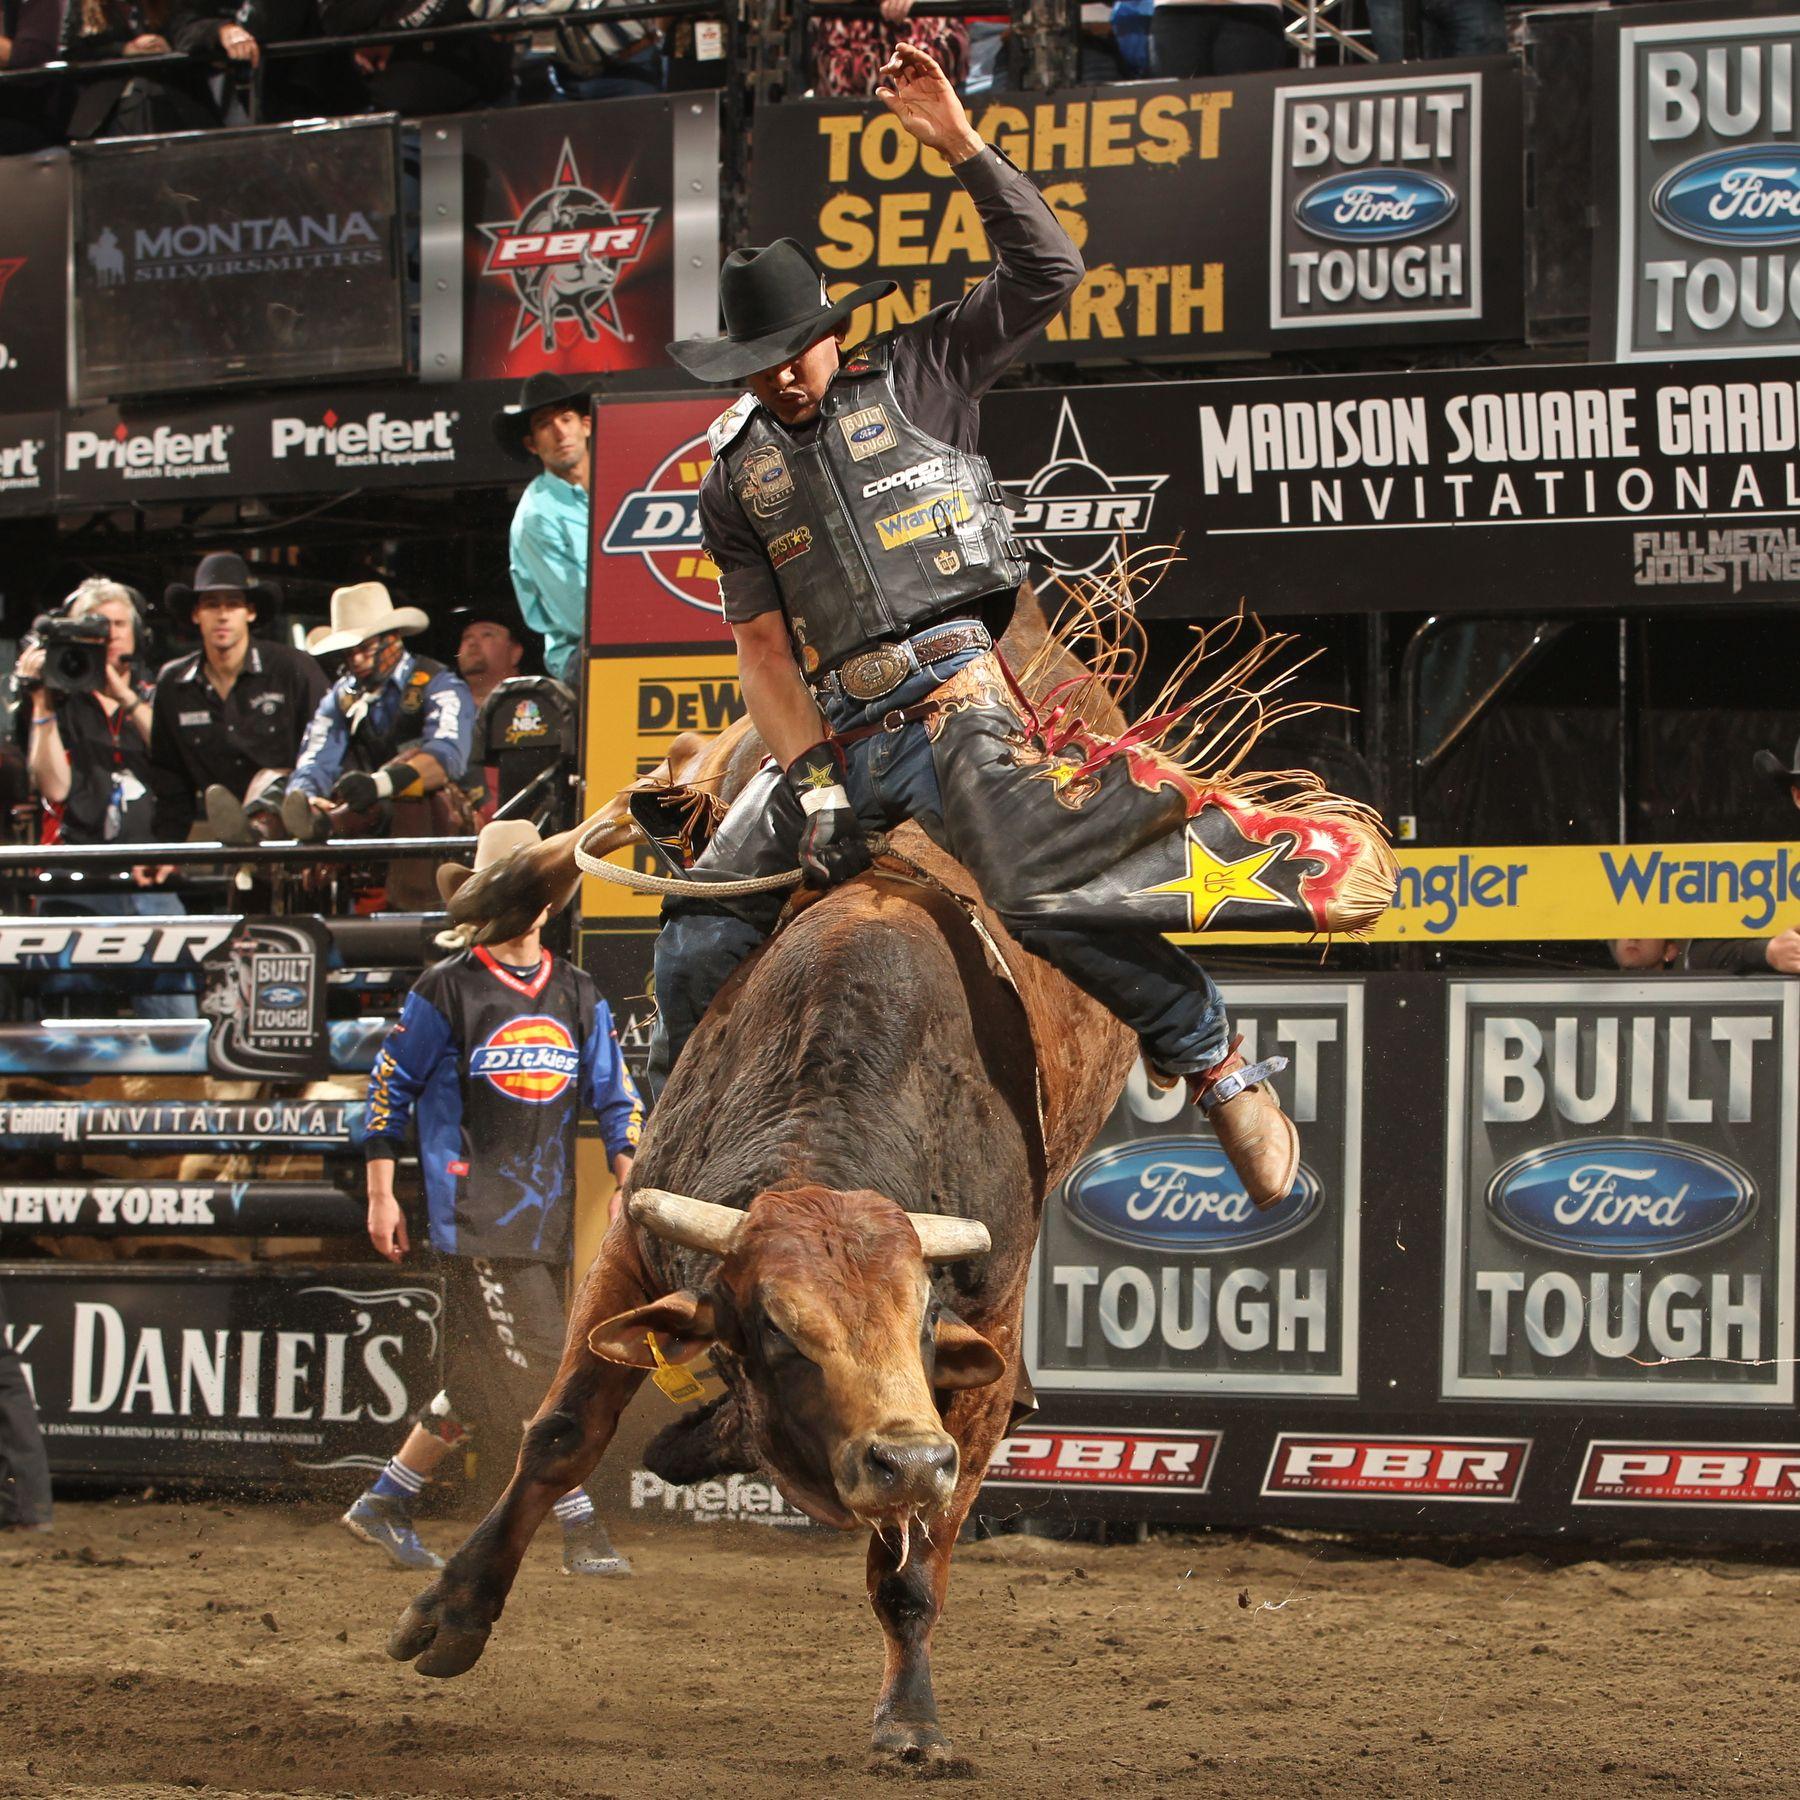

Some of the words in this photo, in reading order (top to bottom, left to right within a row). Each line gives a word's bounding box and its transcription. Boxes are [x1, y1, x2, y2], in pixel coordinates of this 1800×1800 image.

[1292, 93, 1464, 168] BUILT
[1333, 185, 1417, 223] Ford
[1708, 166, 1800, 221] For
[134, 211, 379, 260] MONTANA
[815, 181, 1089, 270] SEAS
[499, 229, 638, 261] PBR
[133, 250, 383, 282] SILVERSMITHS
[1288, 244, 1463, 304] TOUGH
[964, 262, 1225, 342] RTH
[272, 409, 453, 458] Priefert
[845, 408, 884, 432] BUILT
[1199, 397, 1430, 496] MADISON
[1445, 388, 1640, 464] SQUARE
[1656, 381, 1800, 456] GARD
[65, 422, 228, 471] Priefert
[381, 449, 455, 466] Equipment
[166, 463, 230, 479] Equipment
[1279, 463, 1800, 524] INVITATIONAL
[1002, 499, 1142, 531] PBR
[1633, 530, 1705, 567] FULL
[1708, 527, 1800, 556] METAL
[1634, 552, 1800, 594] JOUSTING
[512, 717, 542, 731] NBC
[1394, 855, 1528, 934] ngler
[0, 927, 235, 965] PBR
[257, 959, 309, 983] BUILT
[256, 1009, 308, 1028] TOUGH
[479, 1048, 580, 1071] Dickies
[1482, 1016, 1773, 1124] BUILT
[10, 1106, 79, 1142] GARDEN
[86, 1106, 350, 1134] INVITATIONAL
[92, 1186, 215, 1224] YORK
[1554, 1164, 1690, 1227] Ford
[1053, 1265, 1328, 1353] TOUGH
[1476, 1271, 1763, 1360] TOUGH
[68, 1301, 410, 1425] DANIEL'S
[990, 1437, 1200, 1473] PBR
[1284, 1446, 1509, 1481] PBR
[1098, 1471, 1134, 1480] BULL
[1142, 1473, 1196, 1482] RIDERS
[1281, 1477, 1396, 1488] PROFESSIONAL
[1404, 1480, 1441, 1489] BULL
[1448, 1482, 1505, 1491] RIDERS
[1594, 1485, 1712, 1496] PROFESSIONAL
[1720, 1488, 1758, 1497] BULL
